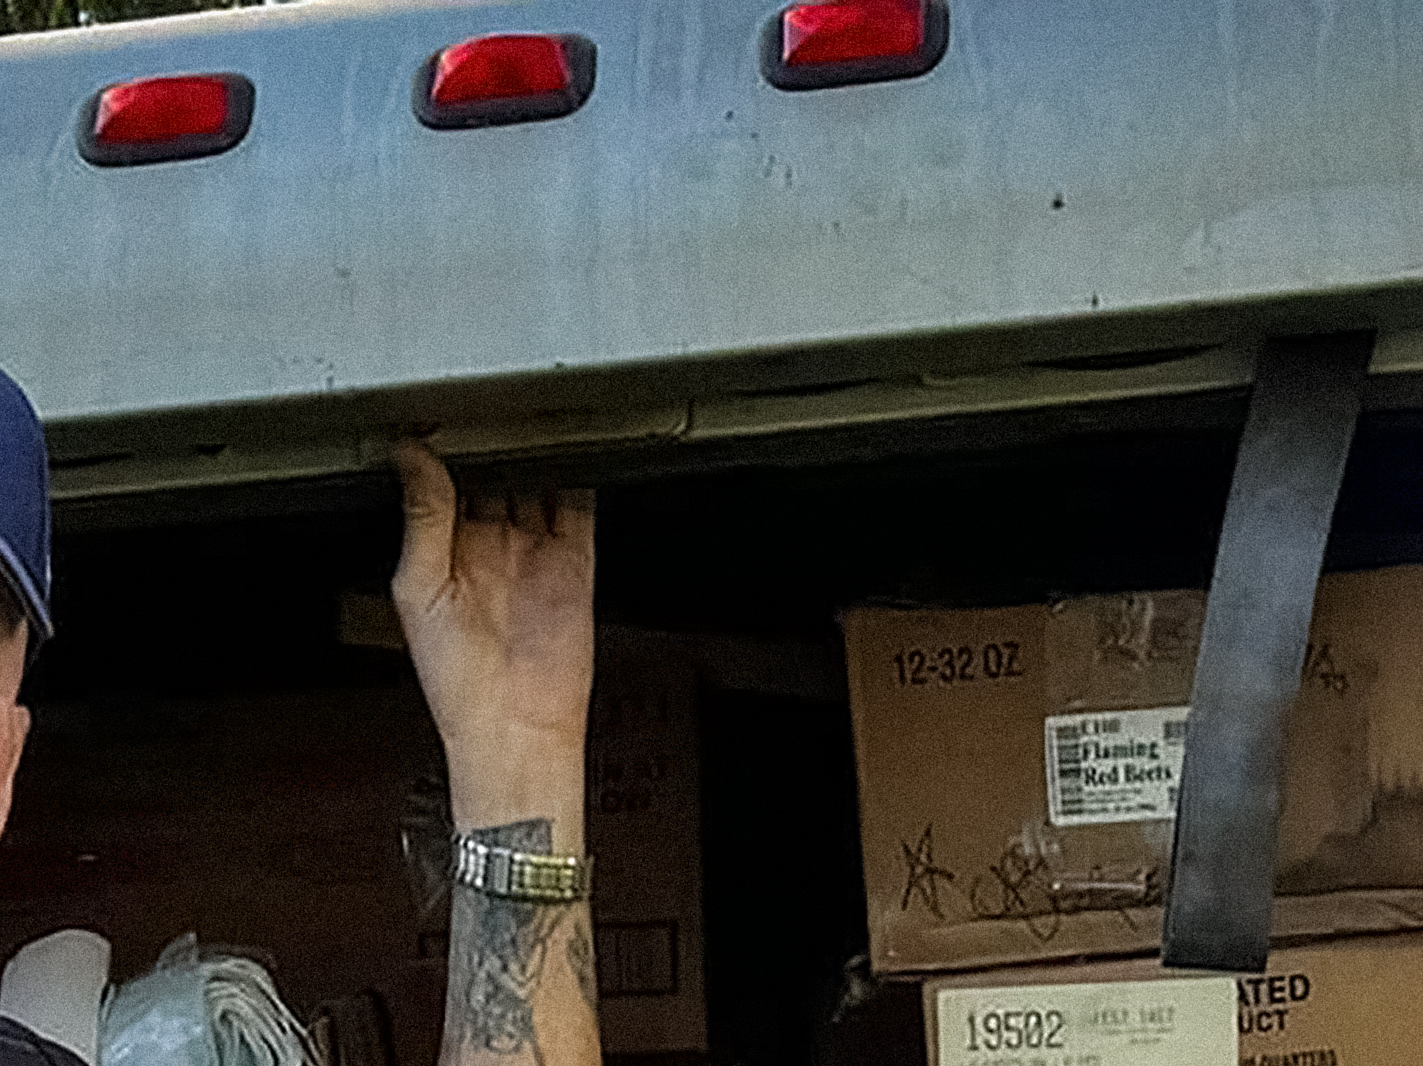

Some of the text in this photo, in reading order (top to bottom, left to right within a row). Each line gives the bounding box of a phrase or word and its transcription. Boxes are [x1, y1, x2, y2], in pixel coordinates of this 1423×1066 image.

[892, 640, 1022, 686] 12-32 OZ
[1082, 738, 1161, 761] Flaming
[1083, 764, 1175, 787] Red Beets
[965, 1010, 1065, 1052] 19502
